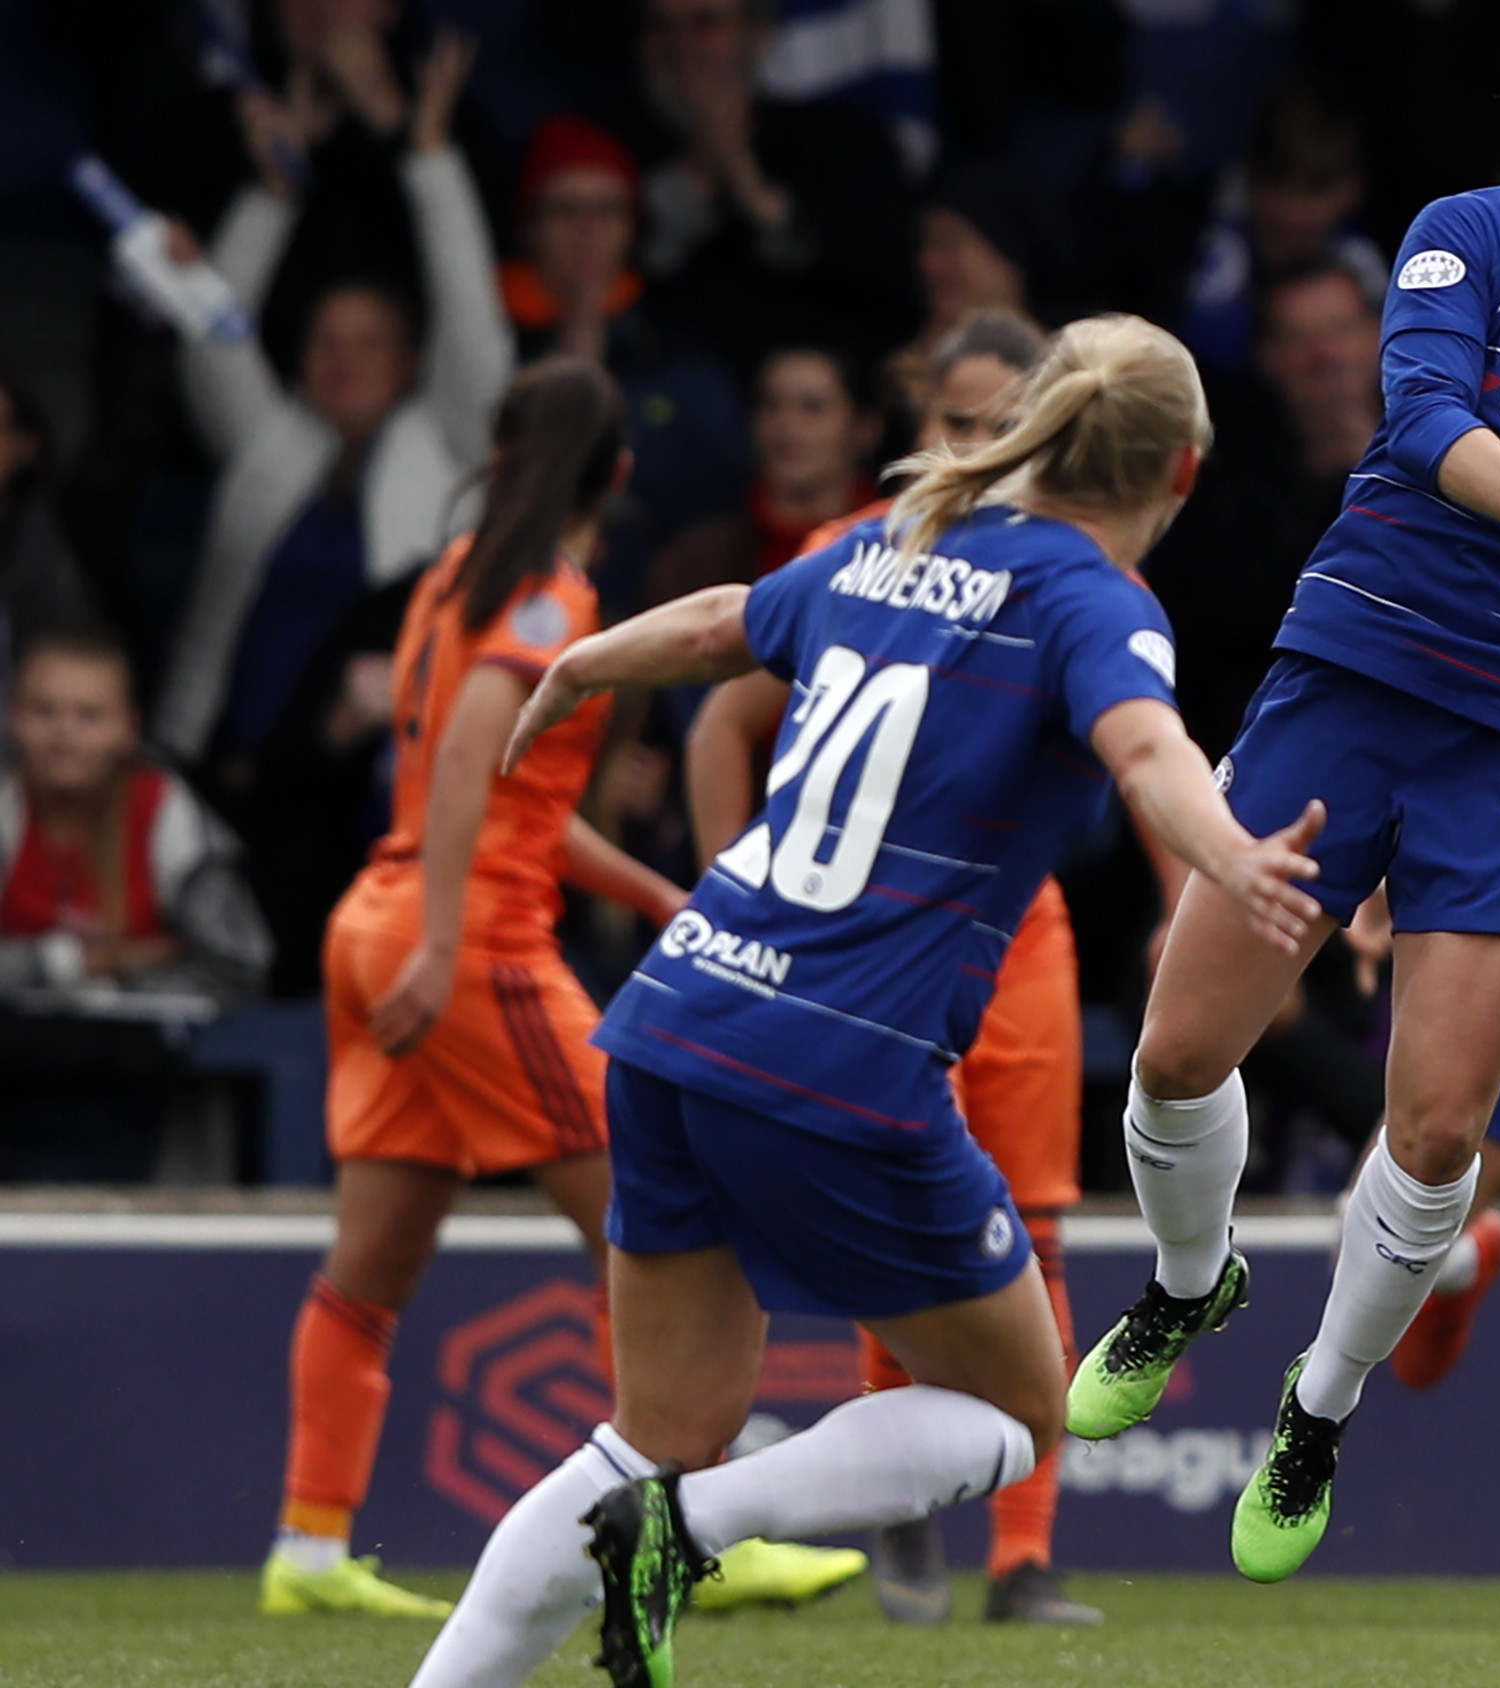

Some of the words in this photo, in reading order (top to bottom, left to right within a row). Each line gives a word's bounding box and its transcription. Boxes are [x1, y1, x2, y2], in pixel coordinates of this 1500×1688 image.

[828, 539, 1013, 623] ANDERSSON
[714, 645, 930, 913] 20
[702, 930, 793, 986] PLAN
[1375, 1243, 1428, 1275] CFC
